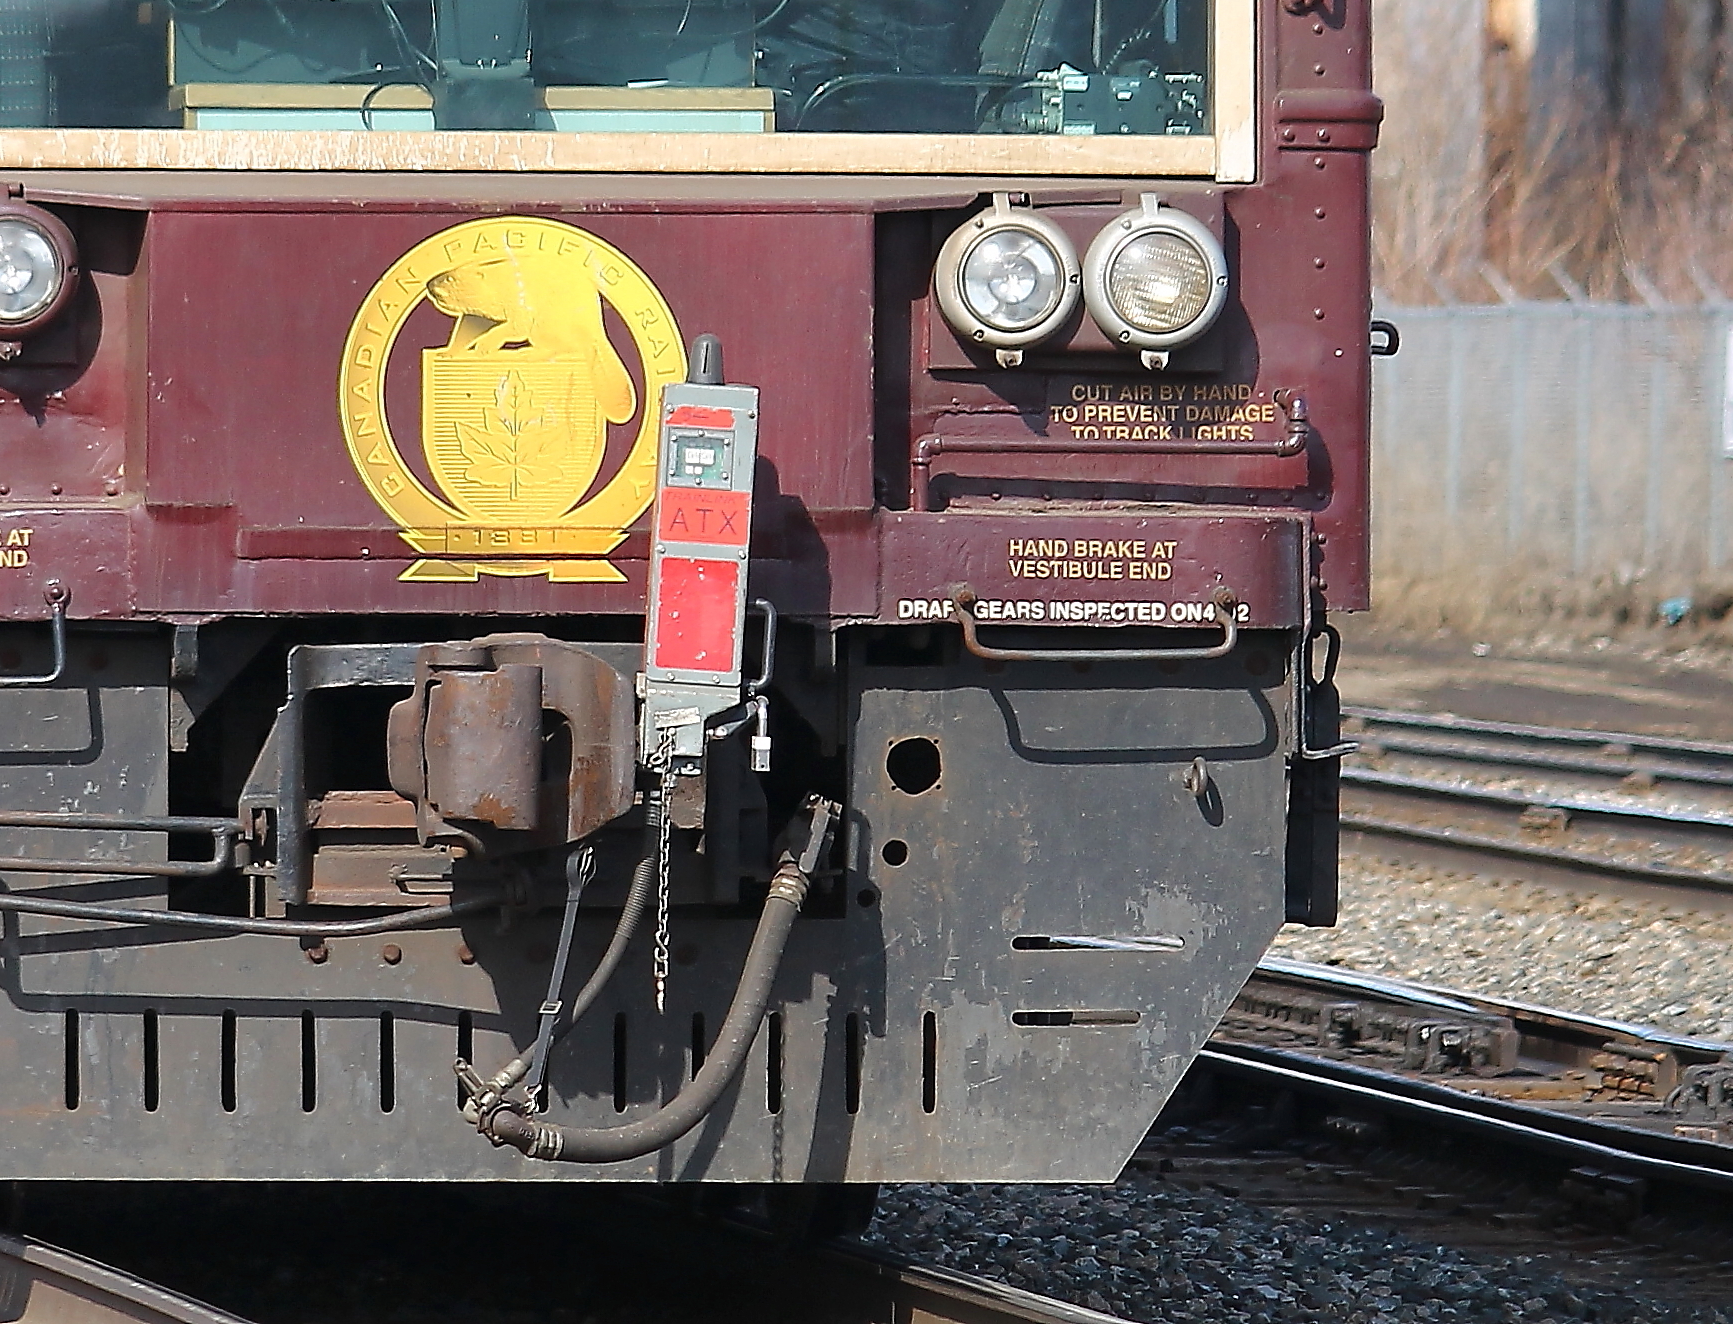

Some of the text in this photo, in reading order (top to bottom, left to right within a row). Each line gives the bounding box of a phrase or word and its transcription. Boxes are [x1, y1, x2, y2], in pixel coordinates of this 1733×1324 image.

[352, 228, 677, 500] CANADIAN PACIFIC RAIAY
[1072, 384, 1251, 402] CUT AIR BY HAND
[1051, 405, 1274, 423] TO PREVENT DAMAGE
[1071, 426, 1099, 440] TO
[1103, 426, 1172, 440] TRACK
[669, 507, 738, 535] ATX
[7, 529, 34, 546] AT
[472, 529, 559, 546] 1881
[1009, 539, 1178, 559] HAND BRAKE AT
[1009, 560, 1171, 580] VESTIBULE END
[898, 599, 956, 619] DRAF
[973, 600, 1044, 620] GEARS
[1049, 601, 1166, 622] INSPECTED
